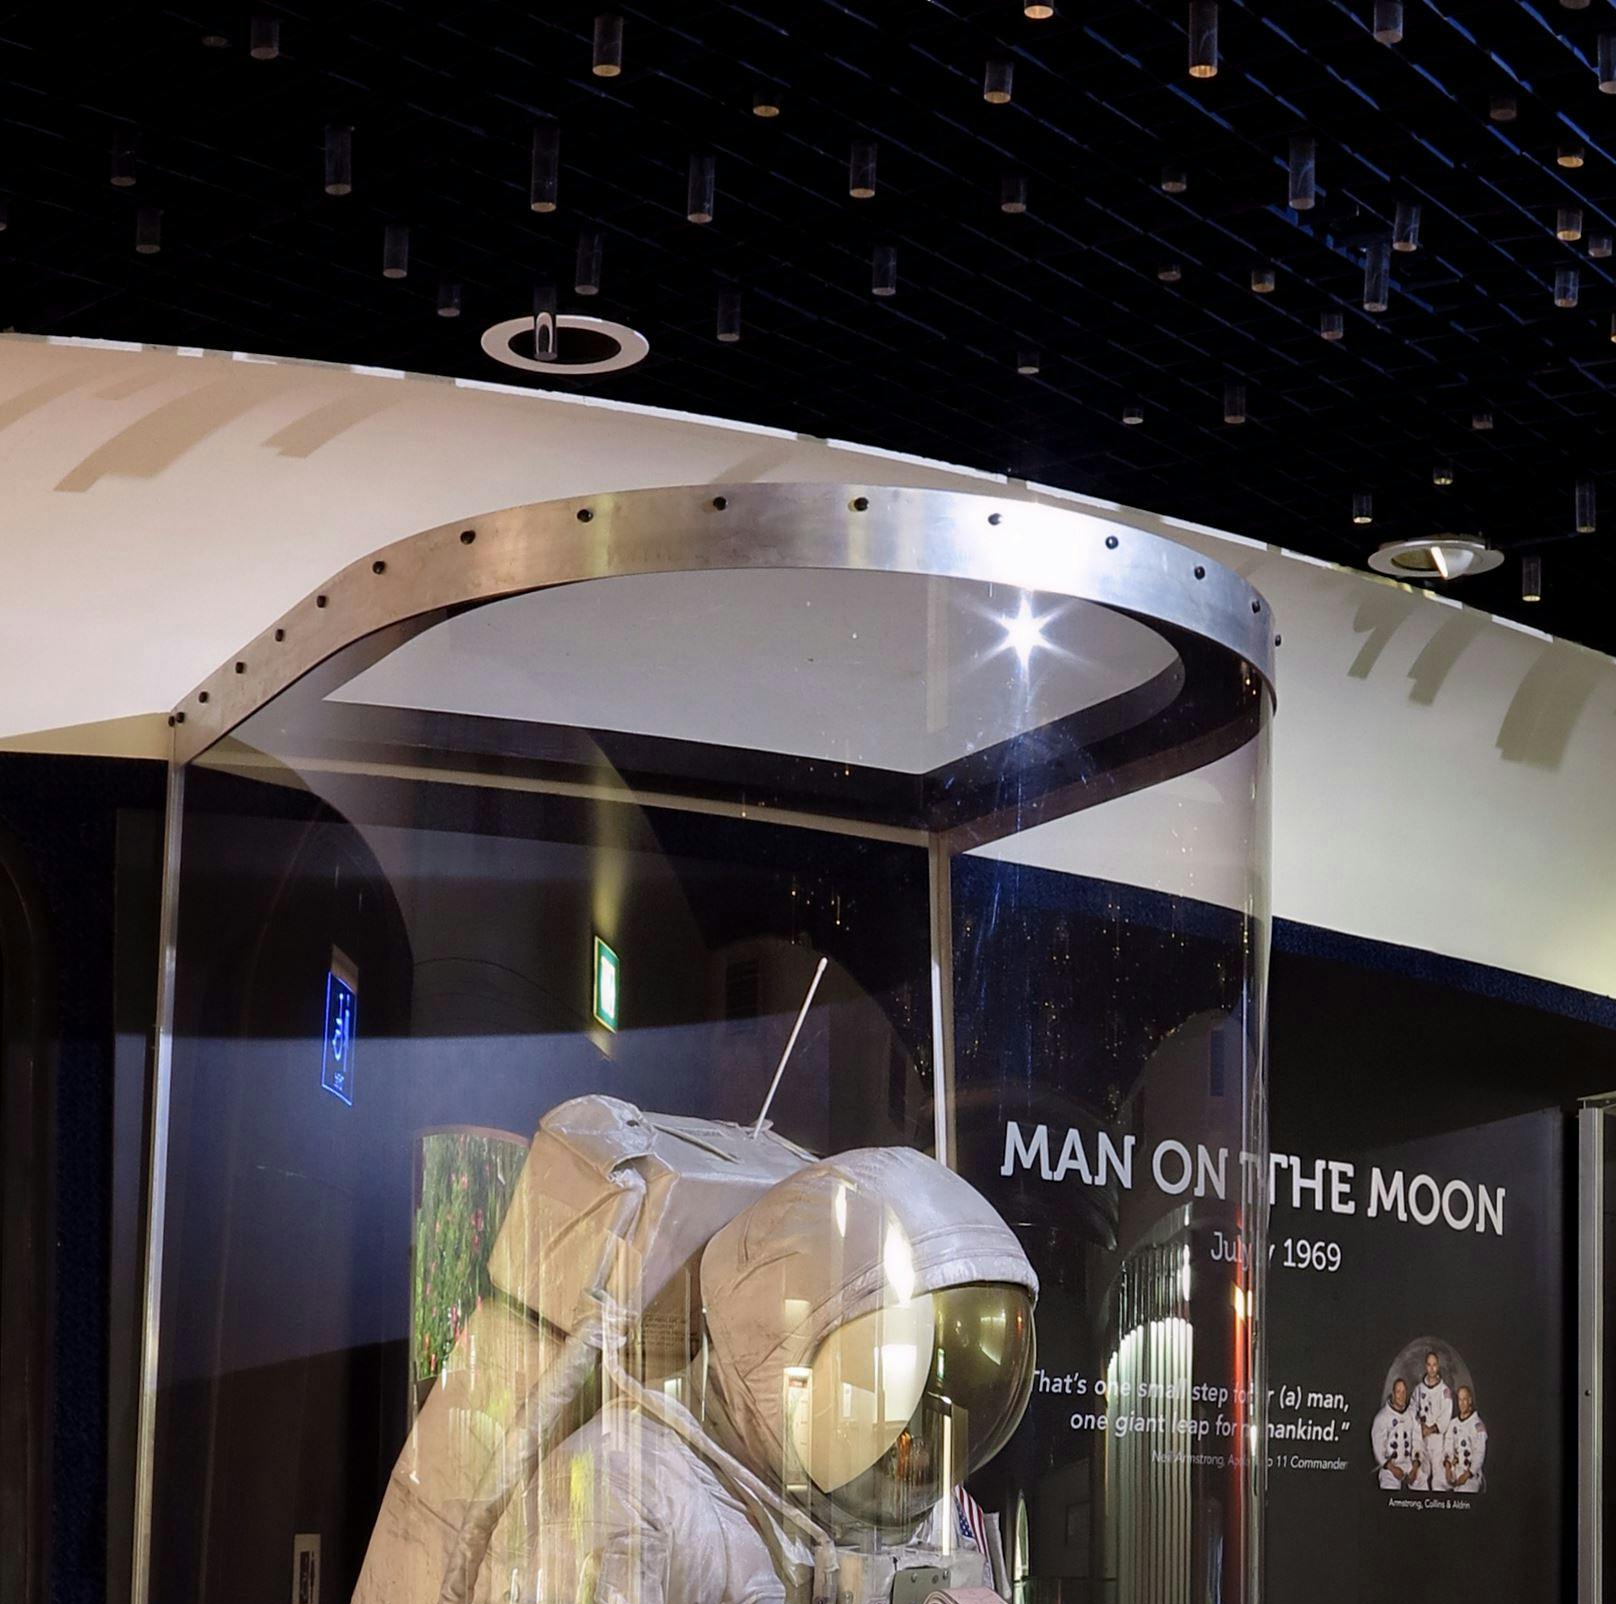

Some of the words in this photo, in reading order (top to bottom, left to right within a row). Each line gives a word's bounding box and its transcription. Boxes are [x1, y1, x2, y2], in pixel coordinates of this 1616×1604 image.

[1001, 1120, 1136, 1189] MAN
[1152, 1139, 1228, 1200] ON
[1263, 1153, 1355, 1214] THE
[1367, 1166, 1506, 1235] MOON
[1283, 1238, 1342, 1272] 1969
[1094, 1378, 1131, 1398] one
[1137, 1378, 1188, 1401] small
[1192, 1381, 1228, 1407] step
[1279, 1385, 1301, 1410] (a)
[1307, 1390, 1350, 1412] man,
[1070, 1411, 1107, 1430] one
[1115, 1412, 1165, 1437] giant
[1172, 1414, 1209, 1439] leap
[1215, 1413, 1237, 1437] for
[1276, 1457, 1287, 1468] 11
[1290, 1458, 1347, 1470] Commander
[1389, 1498, 1423, 1510] Armstrong,
[1424, 1499, 1445, 1509] Collins
[1446, 1500, 1451, 1509] &
[1452, 1500, 1470, 1509] Aldrin
